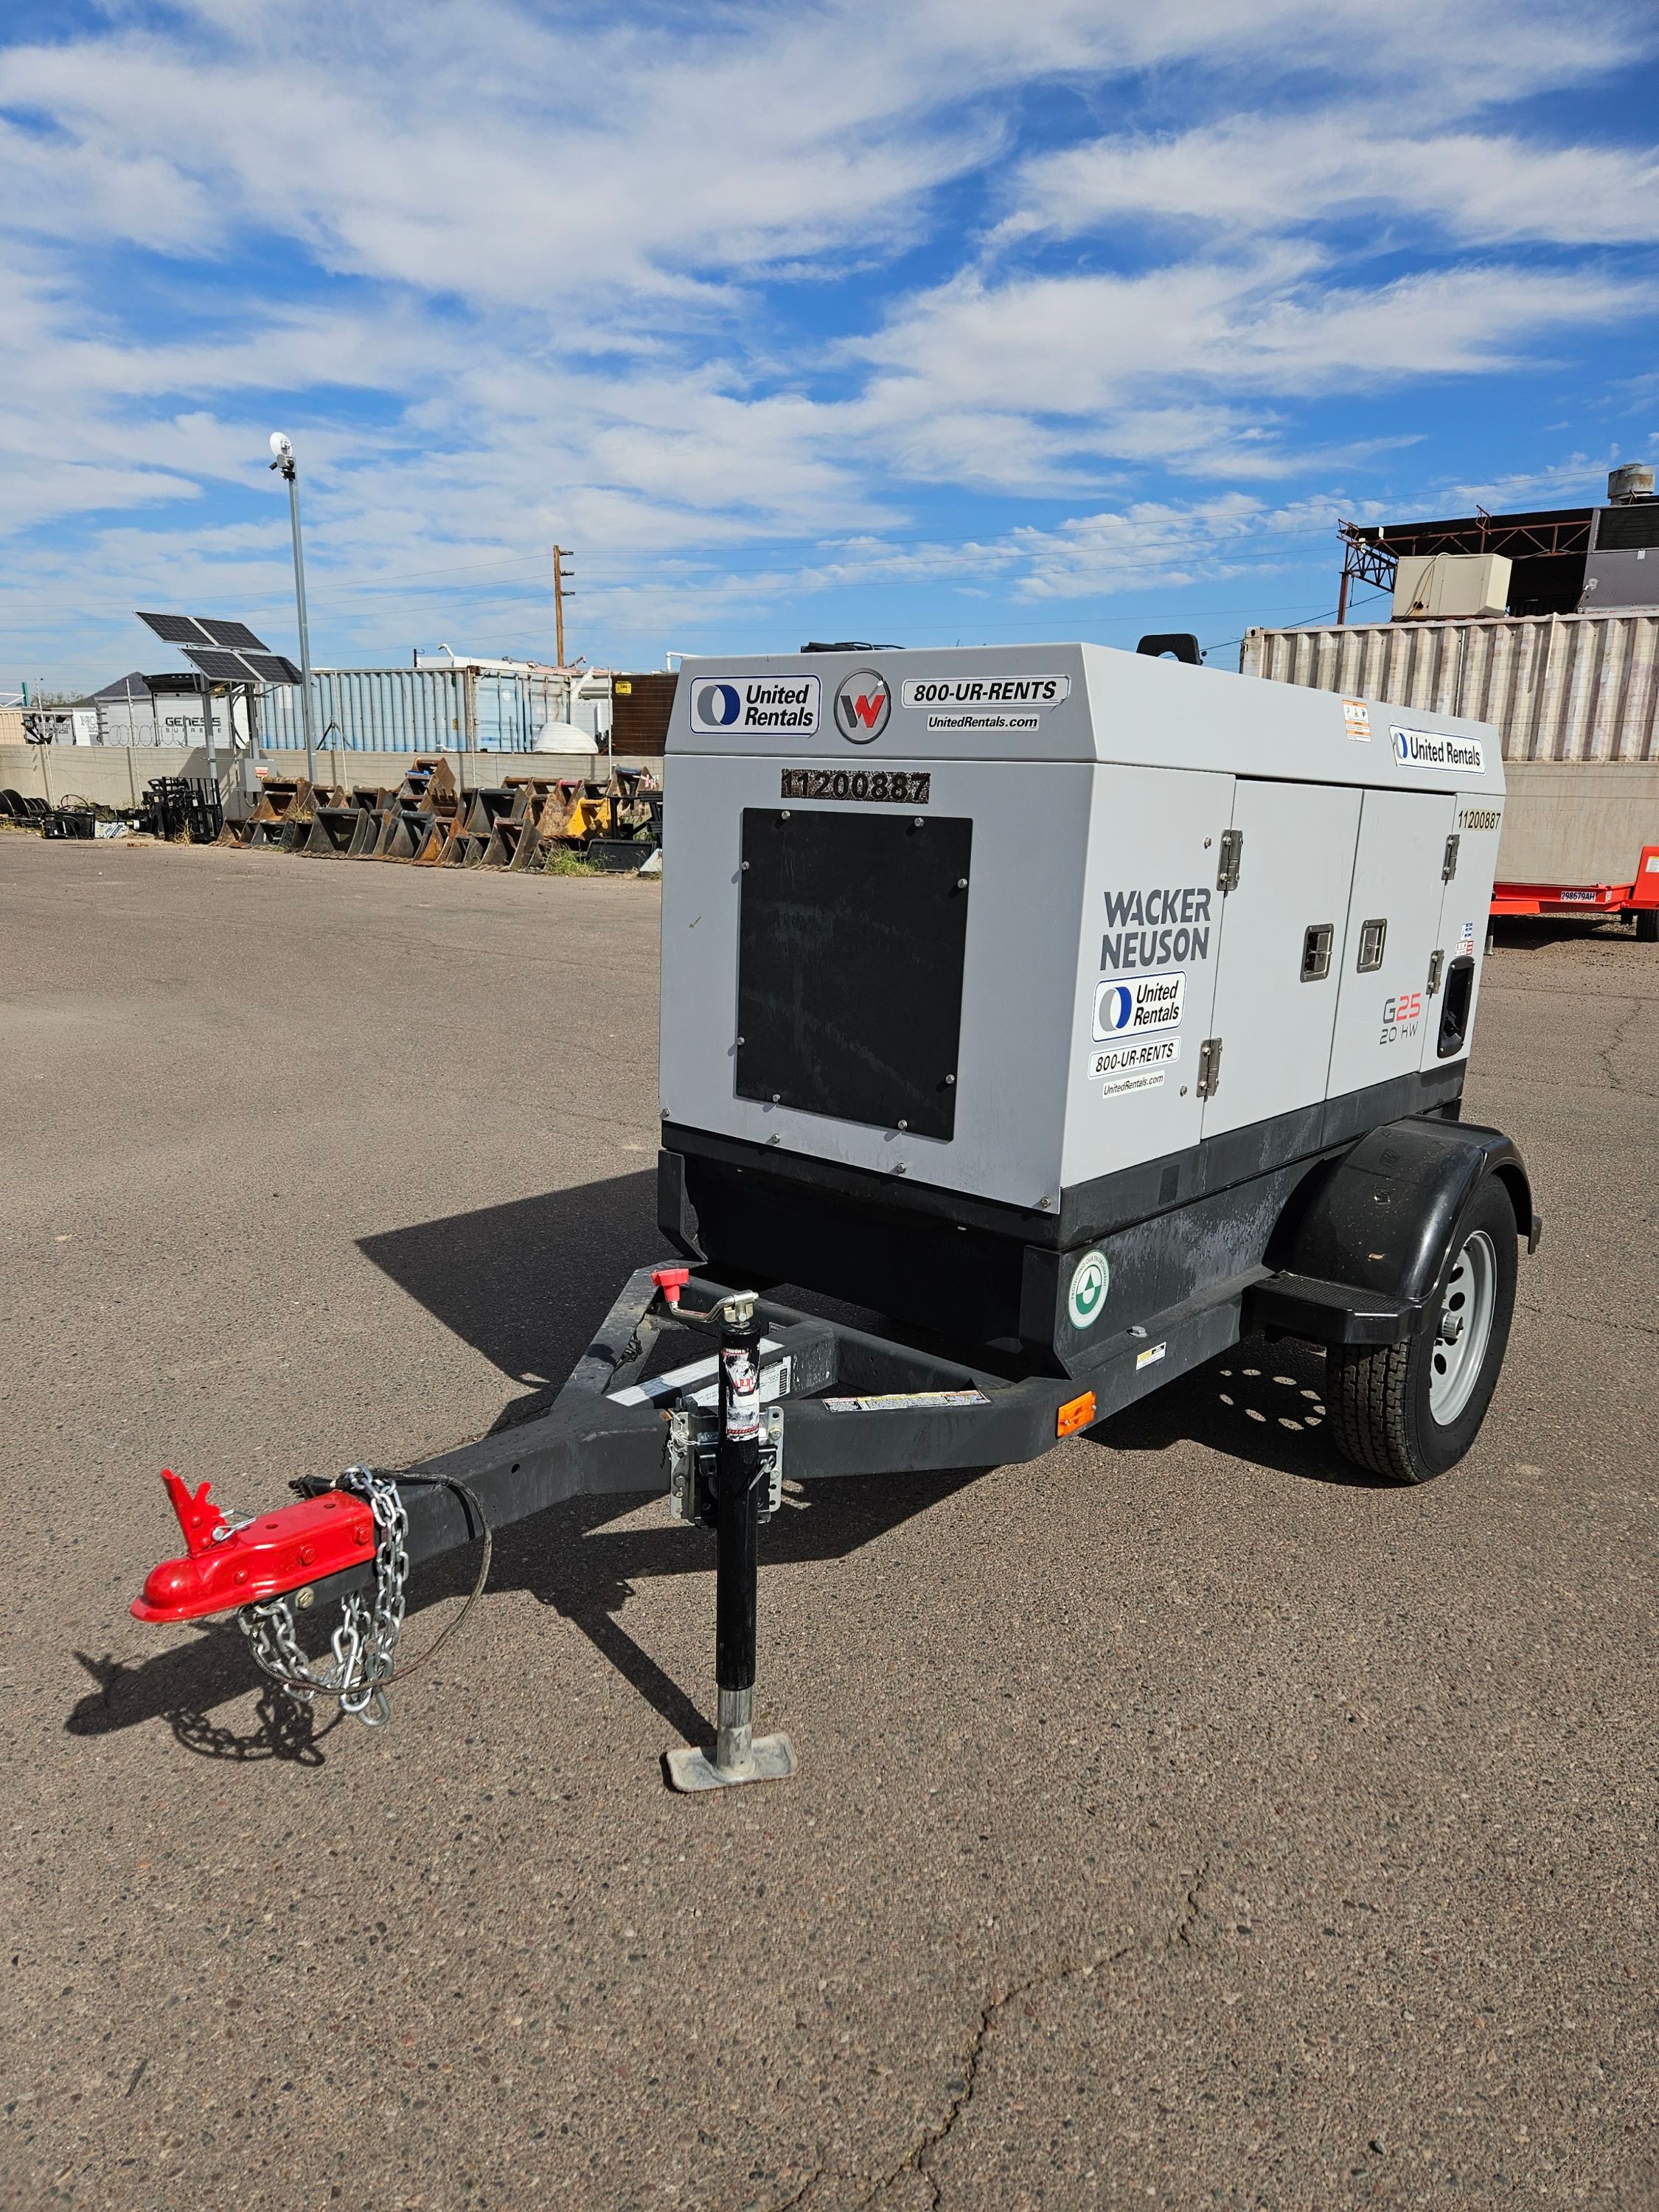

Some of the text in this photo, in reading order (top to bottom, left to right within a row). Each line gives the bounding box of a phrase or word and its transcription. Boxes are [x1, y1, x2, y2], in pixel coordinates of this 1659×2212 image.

[746, 684, 810, 704] United
[914, 681, 1057, 701] 800-UR-RENTS
[745, 707, 813, 726] Rentals
[840, 695, 886, 728] W
[928, 716, 1037, 728] UnitedRentals.com
[1410, 737, 1481, 767] United Rentals
[782, 772, 931, 801] 11200887
[1458, 810, 1500, 830] 11200887
[1562, 891, 1595, 900] 298679AH
[1104, 888, 1211, 928] WACKER
[1100, 926, 1209, 970] NEUSON
[1136, 980, 1179, 1004] United
[1133, 1002, 1180, 1026] Rentals
[1383, 992, 1421, 1023] G25
[1380, 1026, 1397, 1045] 20
[1096, 1043, 1174, 1072] 800-UR-RENTS
[1104, 1075, 1164, 1095] UnitedRentals.com
